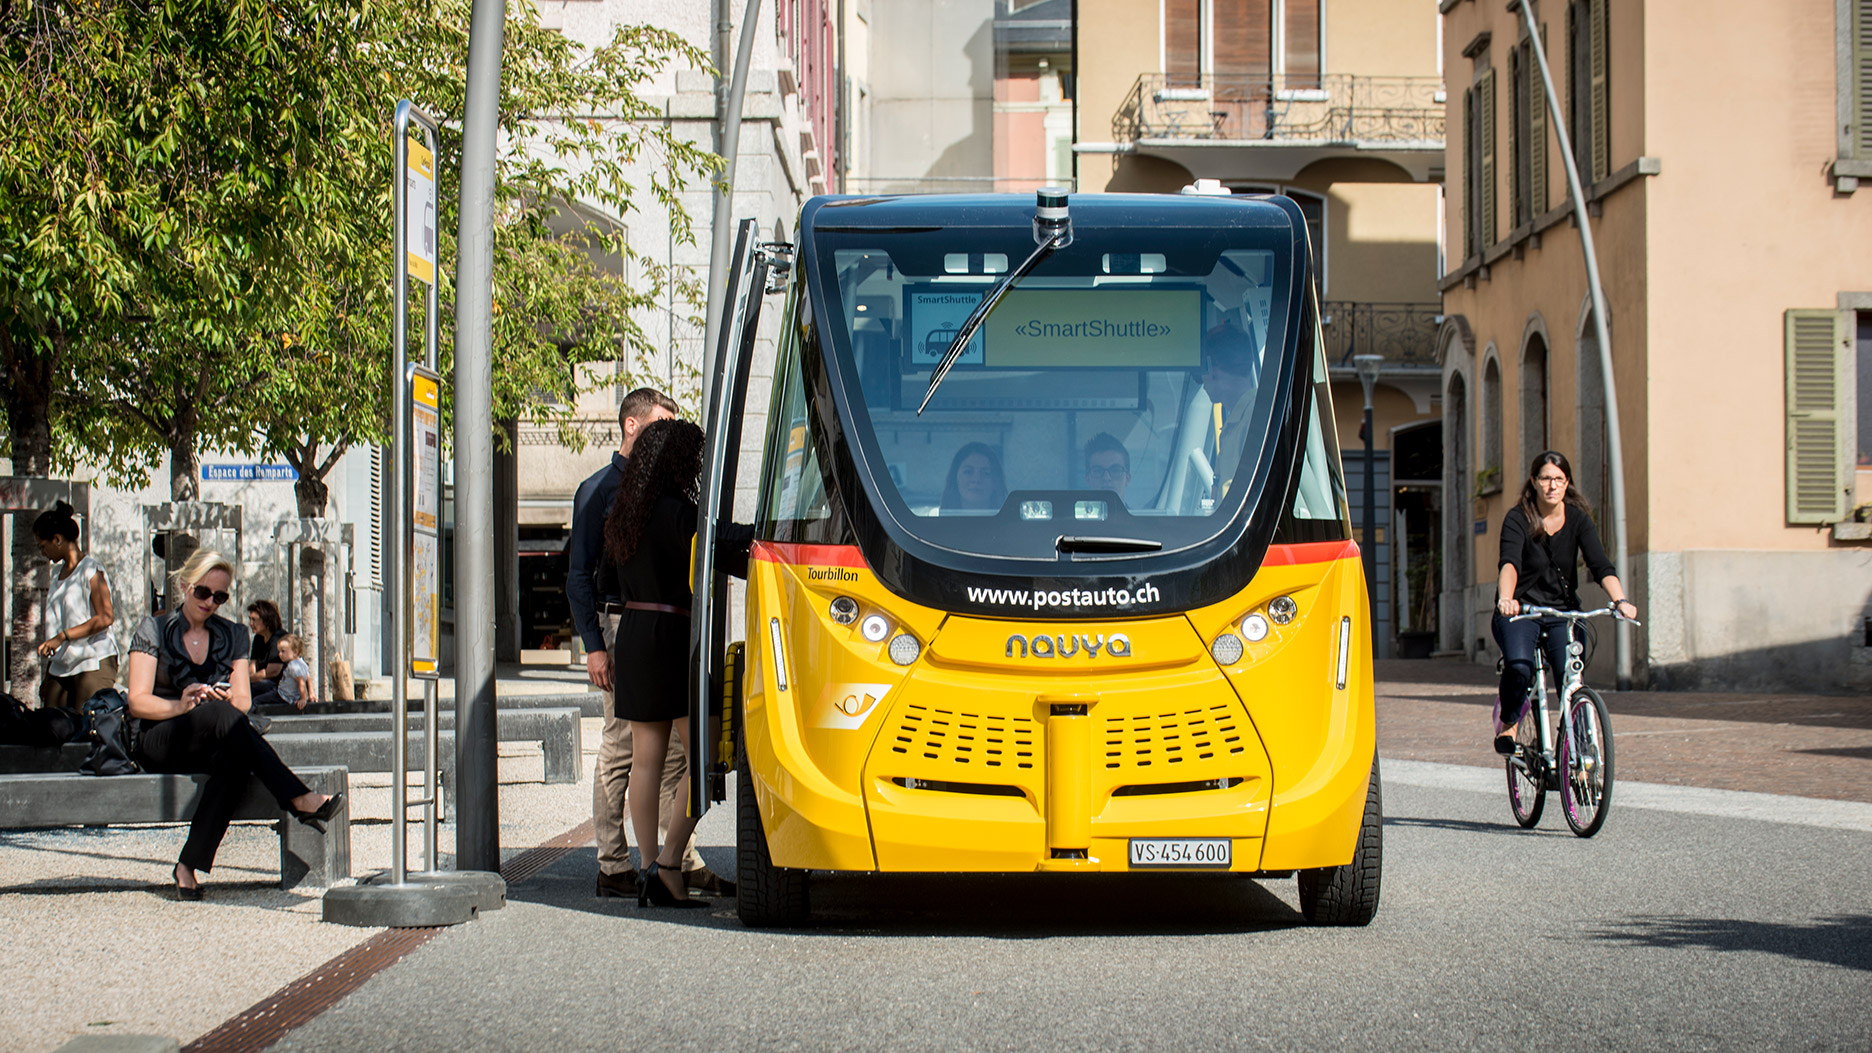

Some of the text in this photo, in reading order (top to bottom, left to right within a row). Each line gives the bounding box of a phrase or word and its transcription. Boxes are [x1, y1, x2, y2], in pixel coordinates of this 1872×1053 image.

[917, 295, 977, 304] SmartShuttle
[1015, 319, 1171, 337] «SmartShuttle»
[208, 465, 293, 479] Espace des Remparts
[807, 567, 859, 582] Tourbillon
[967, 582, 1161, 610] www.postauto.ch
